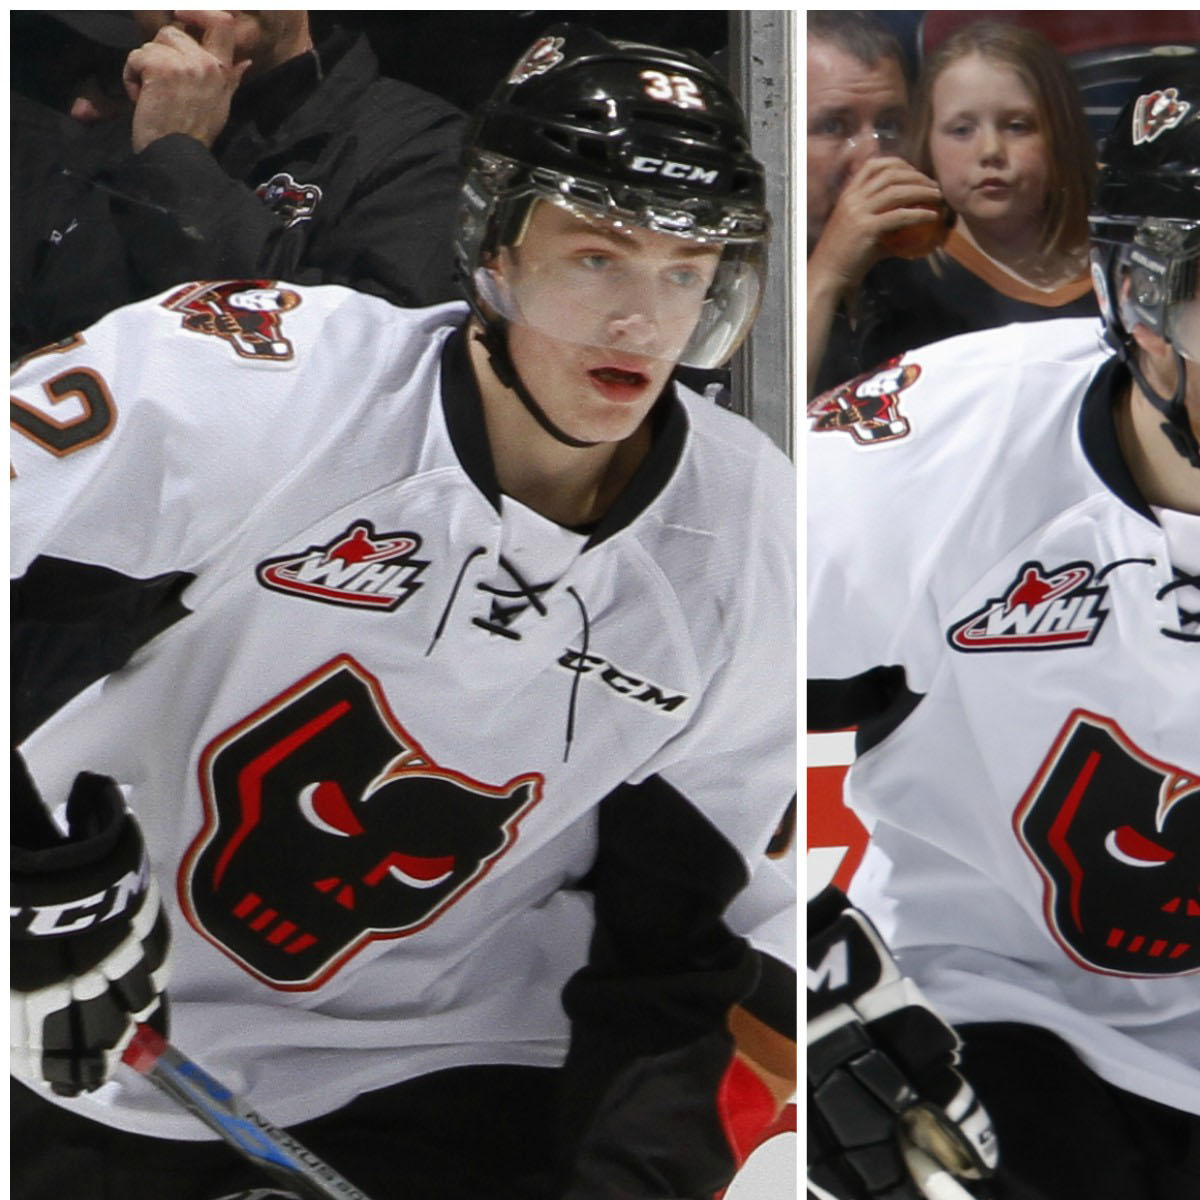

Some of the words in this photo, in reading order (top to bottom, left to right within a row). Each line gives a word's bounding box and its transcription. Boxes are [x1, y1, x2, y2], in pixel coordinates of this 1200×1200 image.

[639, 70, 707, 111] 32
[631, 156, 719, 184] CCM
[296, 552, 418, 595] WHL
[984, 594, 1099, 637] WHL
[557, 648, 689, 712] CCM
[10, 870, 148, 935] CM
[246, 1110, 334, 1181] NEXUS
